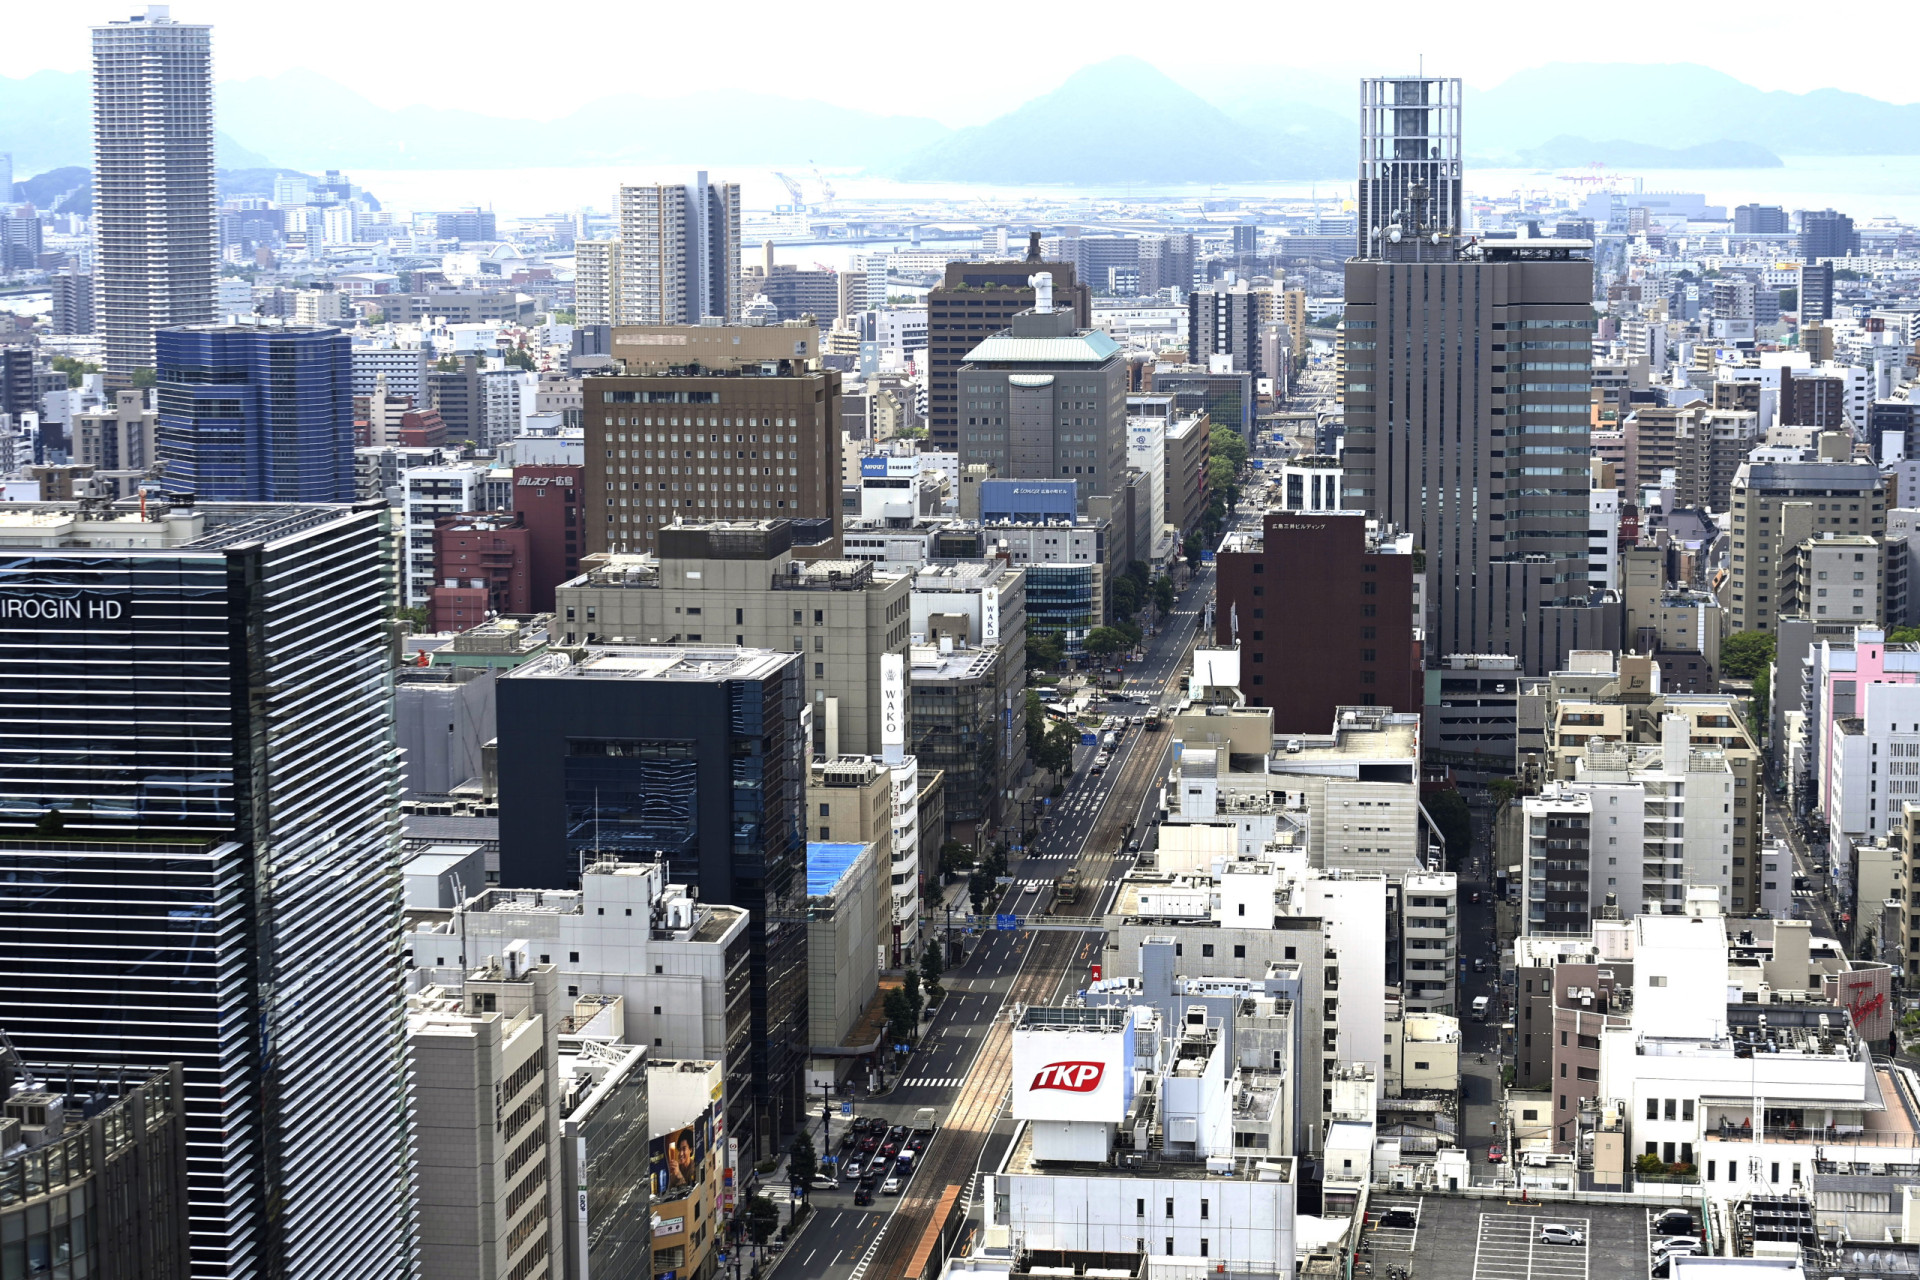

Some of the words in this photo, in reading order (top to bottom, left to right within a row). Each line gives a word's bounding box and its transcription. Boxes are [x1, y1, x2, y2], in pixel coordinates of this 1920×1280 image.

[88, 599, 122, 619] HD
[986, 605, 995, 636] WAKO
[885, 690, 897, 733] WAKO
[1036, 1064, 1100, 1088] TKP
